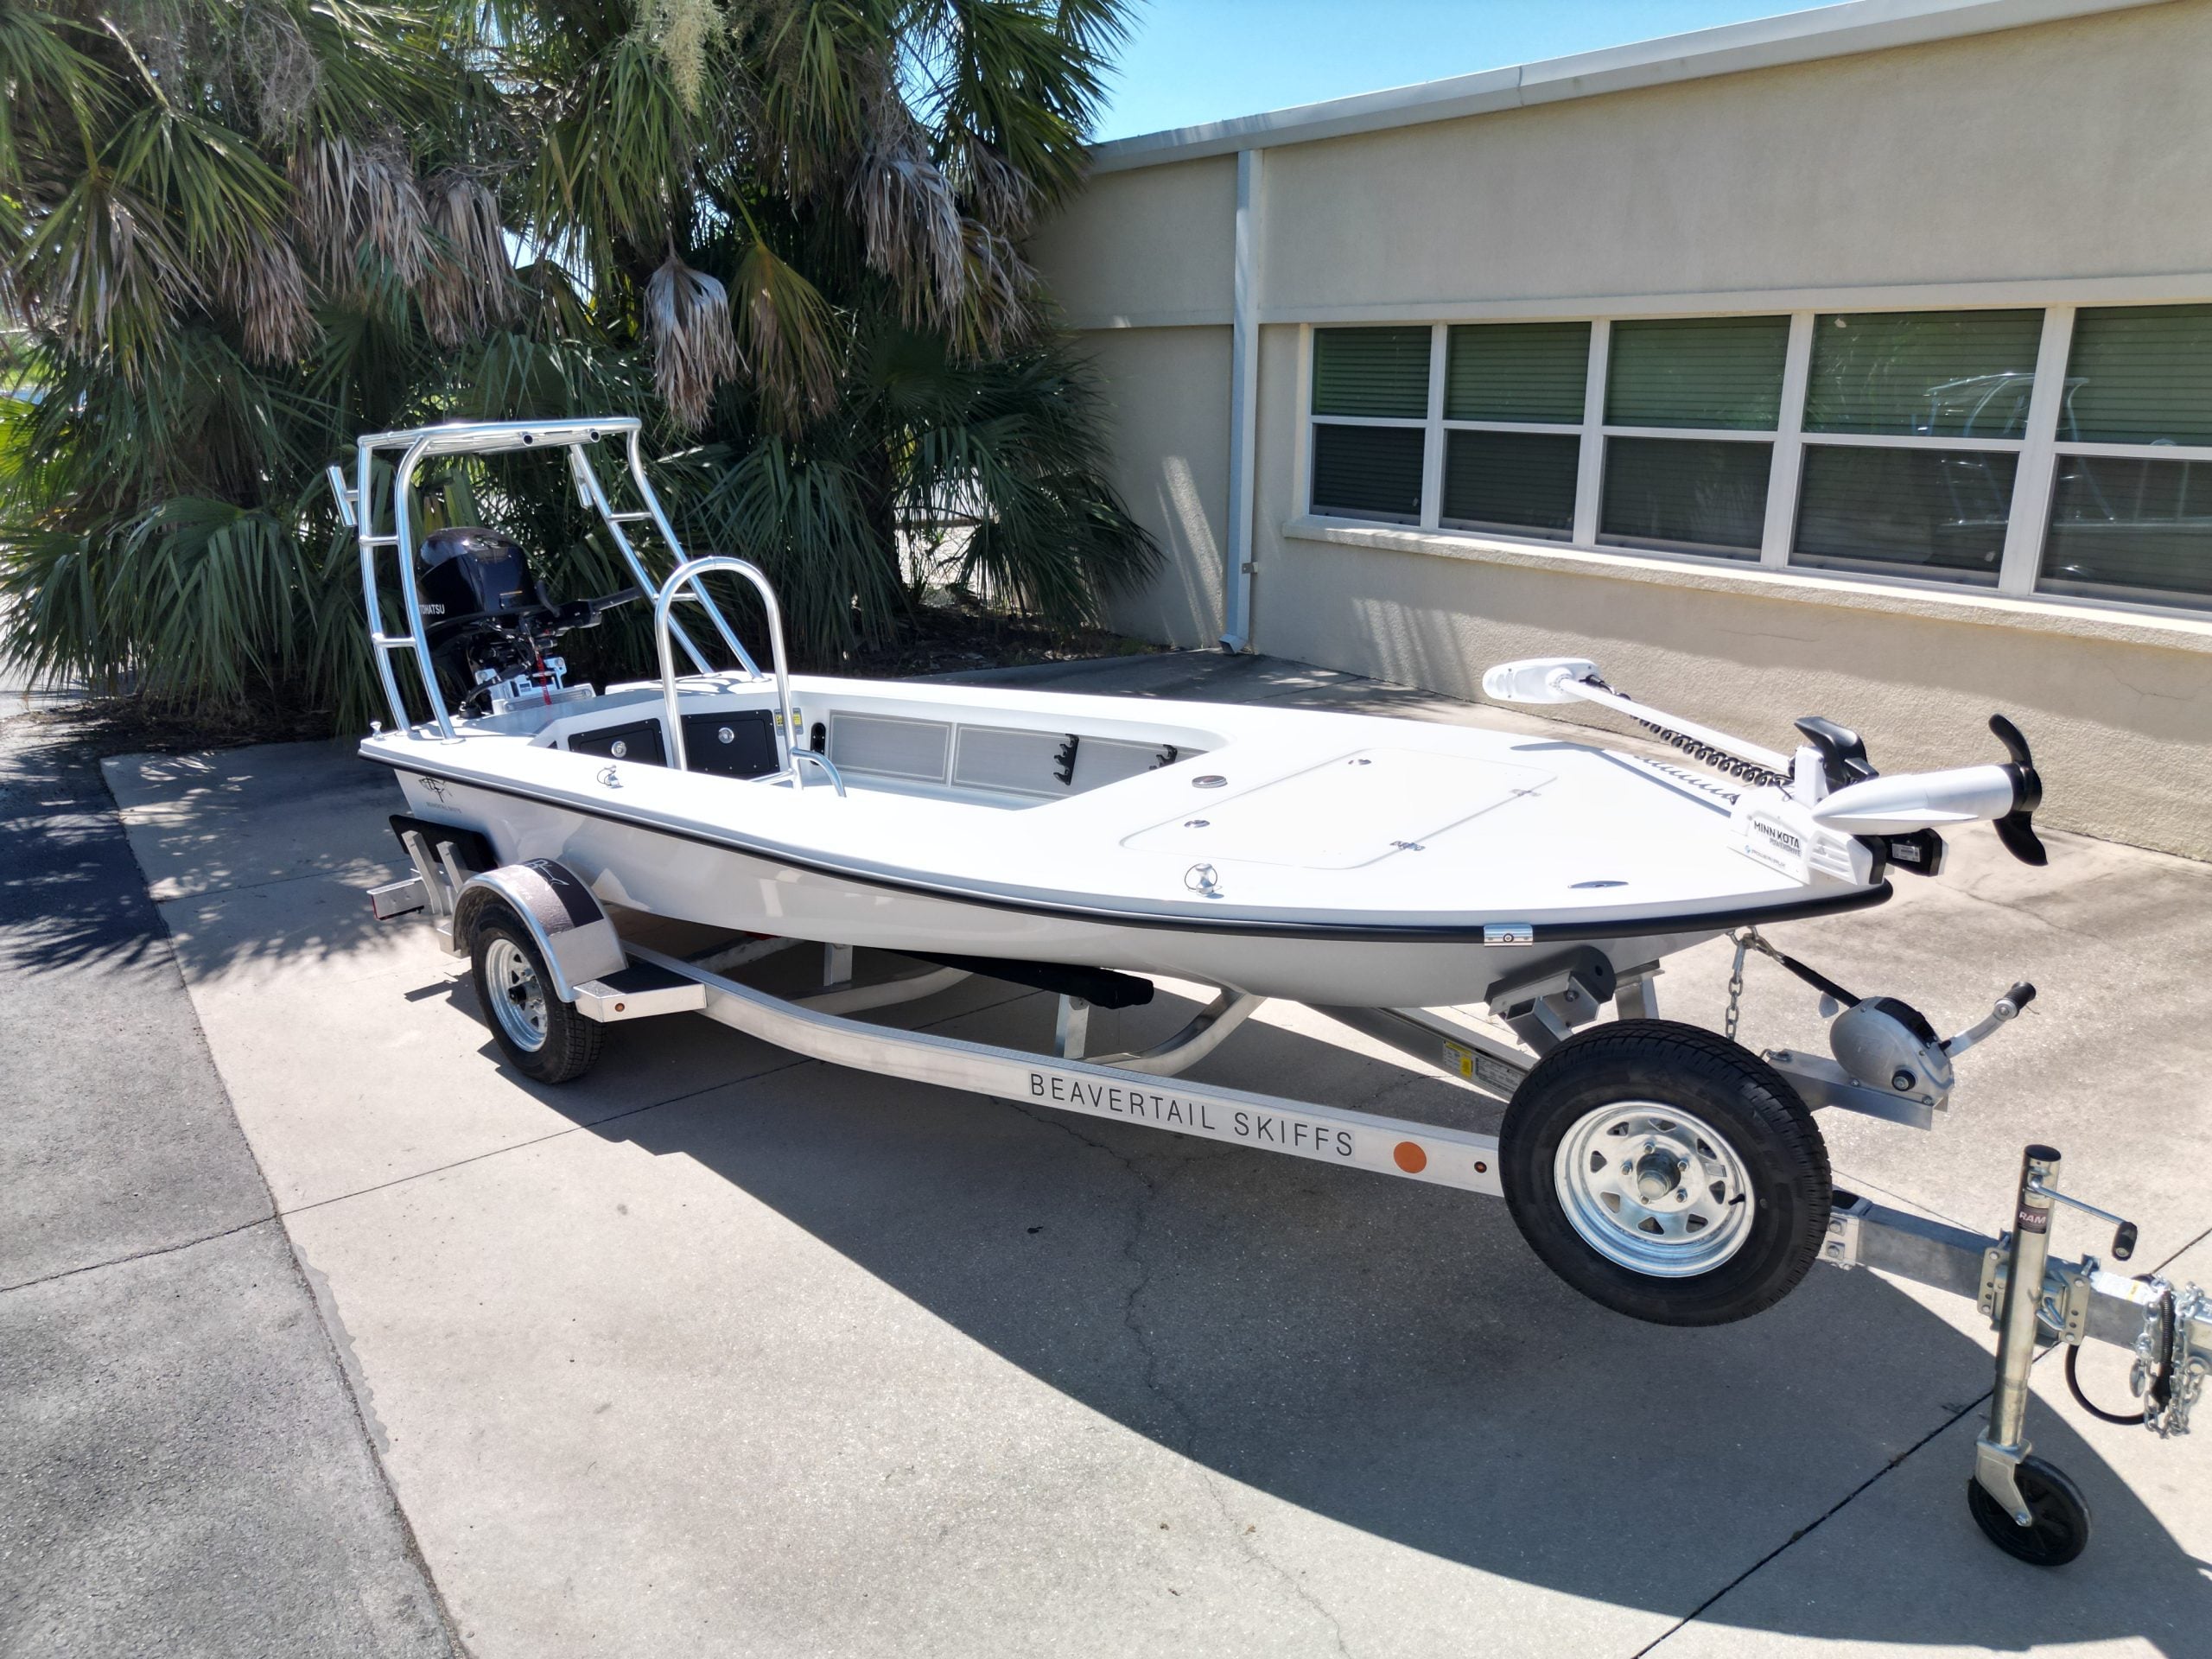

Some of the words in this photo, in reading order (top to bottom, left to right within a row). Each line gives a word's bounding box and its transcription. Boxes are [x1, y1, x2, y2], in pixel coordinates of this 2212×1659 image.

[418, 603, 445, 615] TOHATSU
[1754, 820, 1776, 838] MINN
[1777, 830, 1800, 849] KOTA
[1030, 1072, 1216, 1131] BEAVERTAIL
[1234, 1111, 1354, 1158] SKIFFS
[2018, 1211, 2047, 1224] RAM
